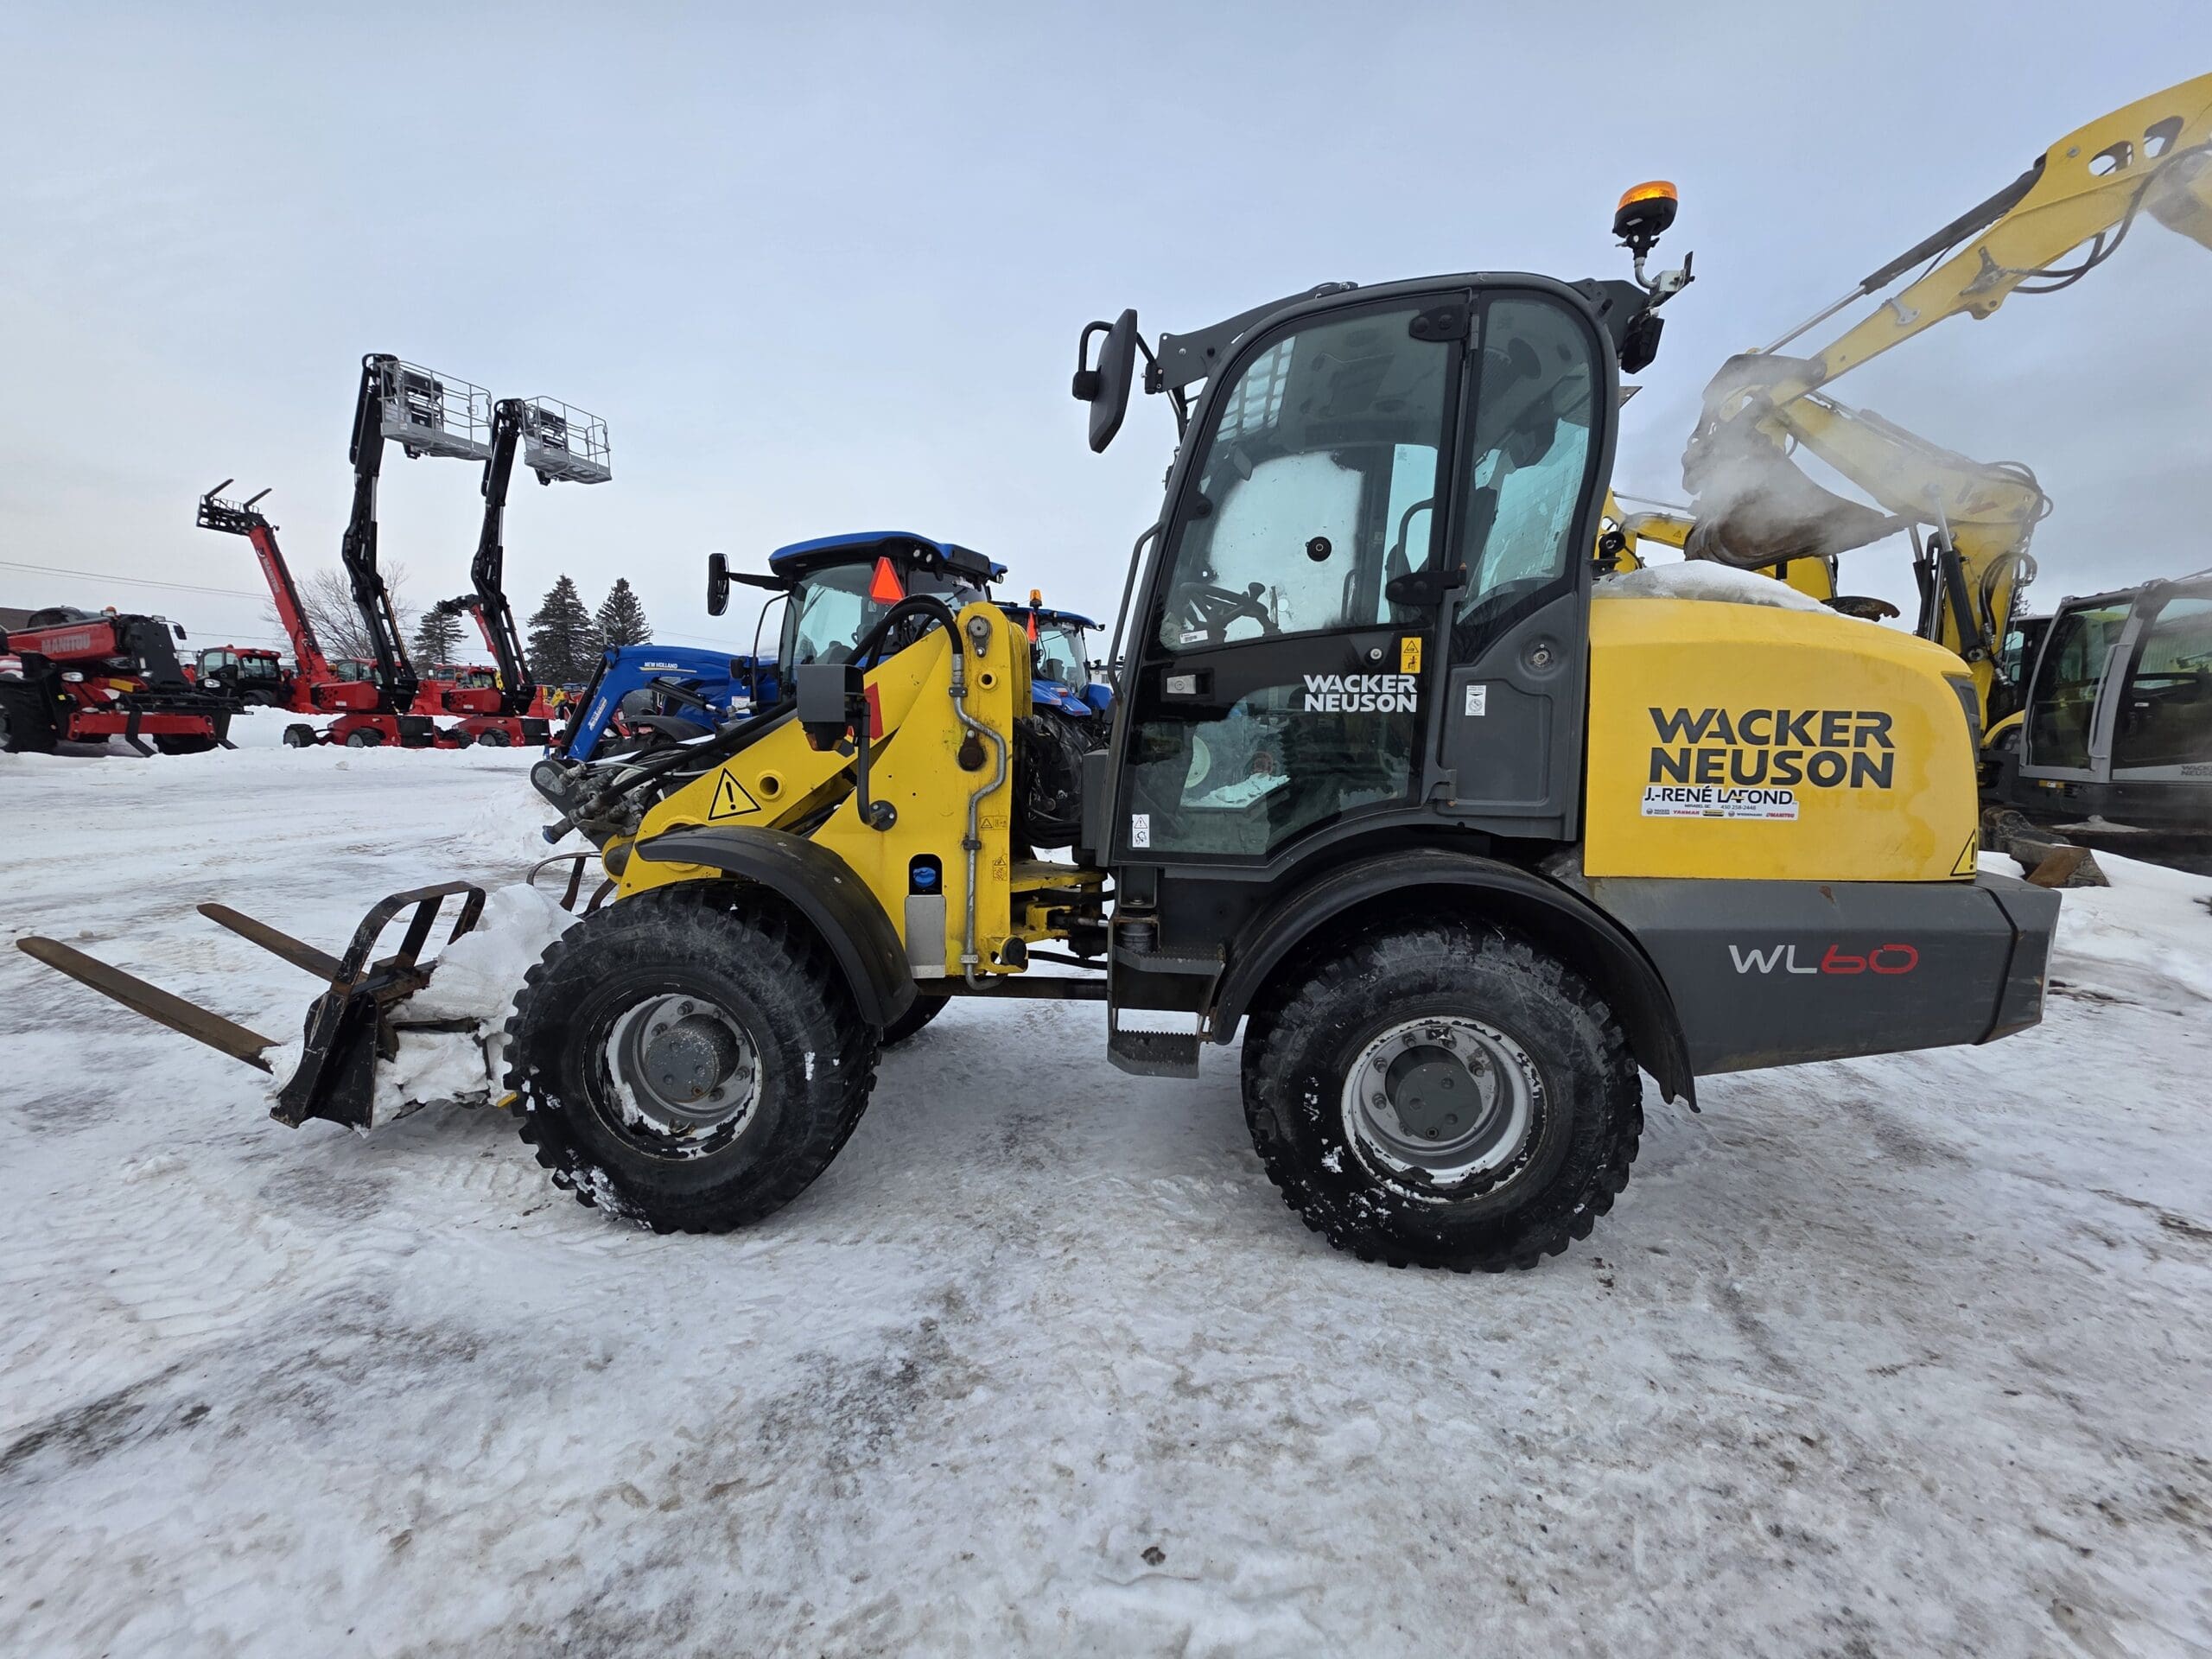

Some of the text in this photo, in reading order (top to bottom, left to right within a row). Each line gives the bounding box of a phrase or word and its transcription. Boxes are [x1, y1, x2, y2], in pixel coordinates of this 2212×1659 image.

[41, 632, 91, 654] MANITOU
[1303, 674, 1418, 693] WACKER
[1304, 694, 1418, 713] NEUSON
[1648, 707, 1896, 749] WACKER
[1649, 747, 1895, 789] NEUSON
[1644, 785, 1713, 803] J.-RENÉ
[1717, 789, 1794, 805] LAFOND
[1728, 944, 1919, 975] WL60
